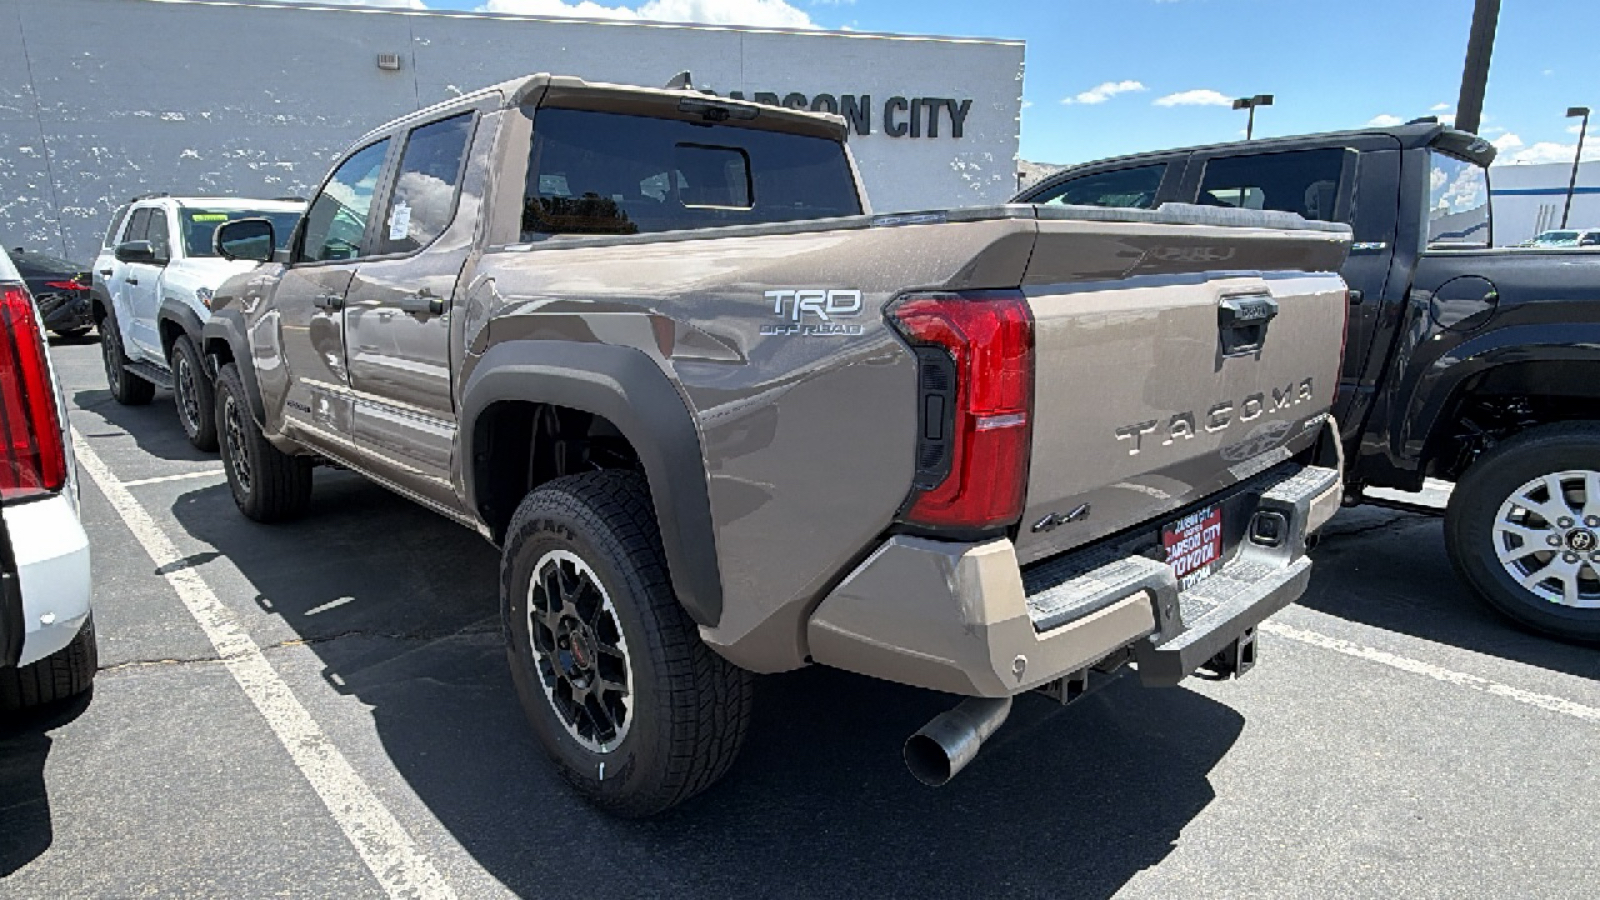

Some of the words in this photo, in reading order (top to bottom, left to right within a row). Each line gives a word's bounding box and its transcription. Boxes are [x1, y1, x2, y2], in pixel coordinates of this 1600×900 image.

[884, 97, 972, 138] CITY
[764, 289, 861, 321] TRD
[1114, 377, 1313, 455] TACOMA
[1165, 531, 1201, 563] CARSON
[1203, 522, 1221, 543] CITY
[1170, 542, 1215, 577] TOYOTA
